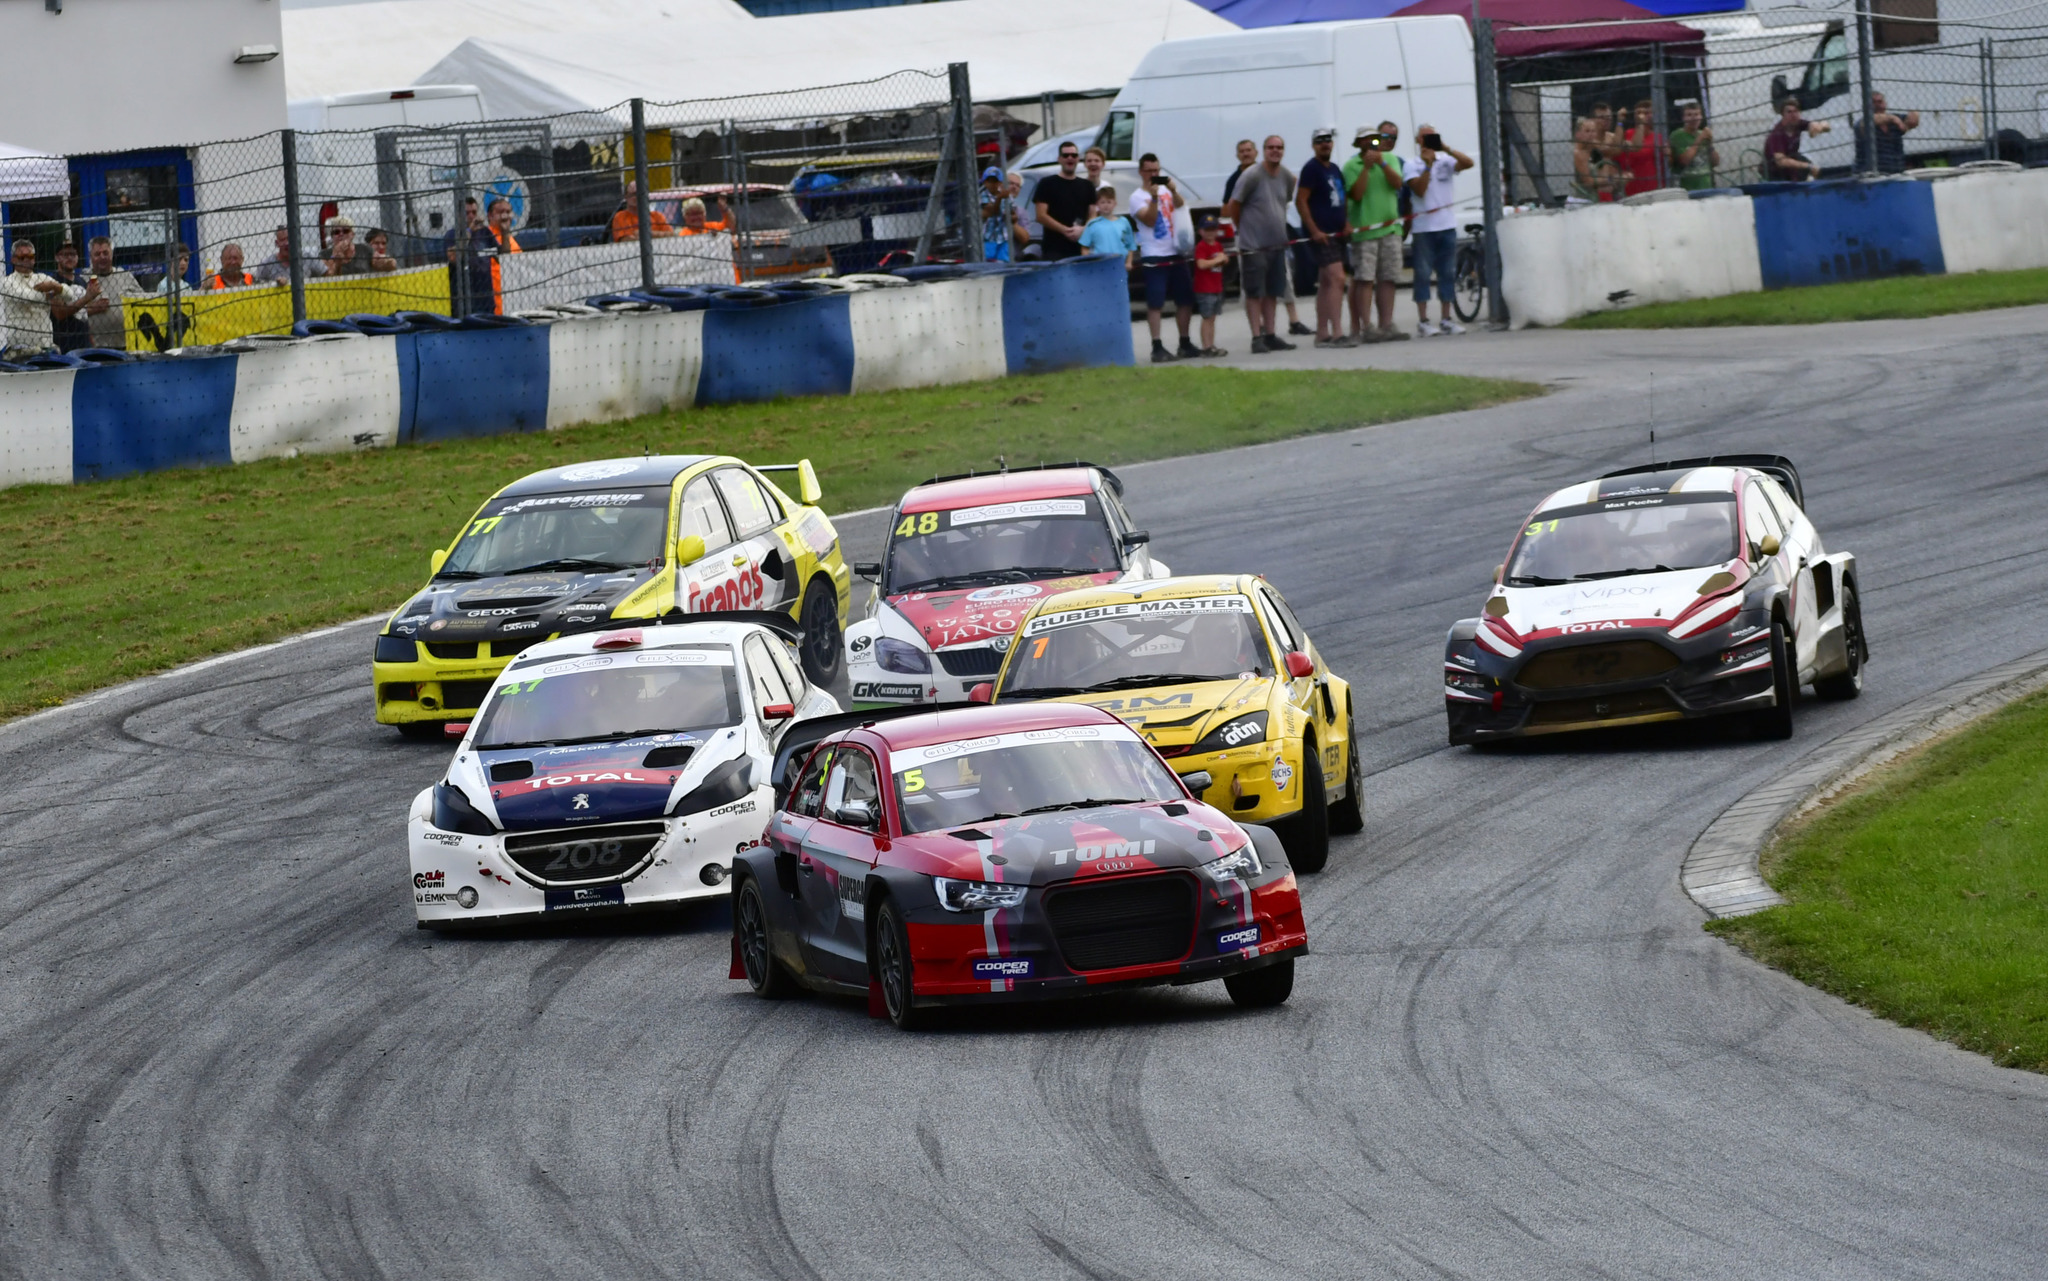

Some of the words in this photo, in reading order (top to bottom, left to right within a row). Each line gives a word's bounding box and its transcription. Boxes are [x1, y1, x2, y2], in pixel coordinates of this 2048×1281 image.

[1627, 498, 1664, 506] Pucher
[468, 515, 503, 537] 77
[895, 511, 939, 538] 48
[1523, 518, 1560, 536] 31
[467, 607, 518, 617] GEOX
[1031, 605, 1129, 630] RUBBLE
[1140, 599, 1244, 612] MASTER
[1555, 620, 1632, 635] TOTAL
[1032, 636, 1050, 659] 1
[499, 678, 545, 696] 47
[853, 682, 880, 698] GK
[879, 687, 921, 696] KONTAKT
[1225, 720, 1263, 746] atm
[524, 771, 645, 789] TOTAL
[903, 769, 926, 793] 5
[1271, 767, 1292, 779] FUCHS
[709, 801, 756, 818] COOPER
[734, 806, 757, 816] TIRES
[423, 833, 463, 842] COOPER
[544, 838, 623, 871] 208
[1049, 839, 1156, 866] TOMI
[420, 879, 445, 889] Gumi
[424, 890, 446, 903] ÉMK
[1220, 927, 1258, 944] COOPER
[1239, 936, 1258, 945] TIRES
[976, 961, 1030, 972] COOPER
[1001, 967, 1029, 976] TIRES
